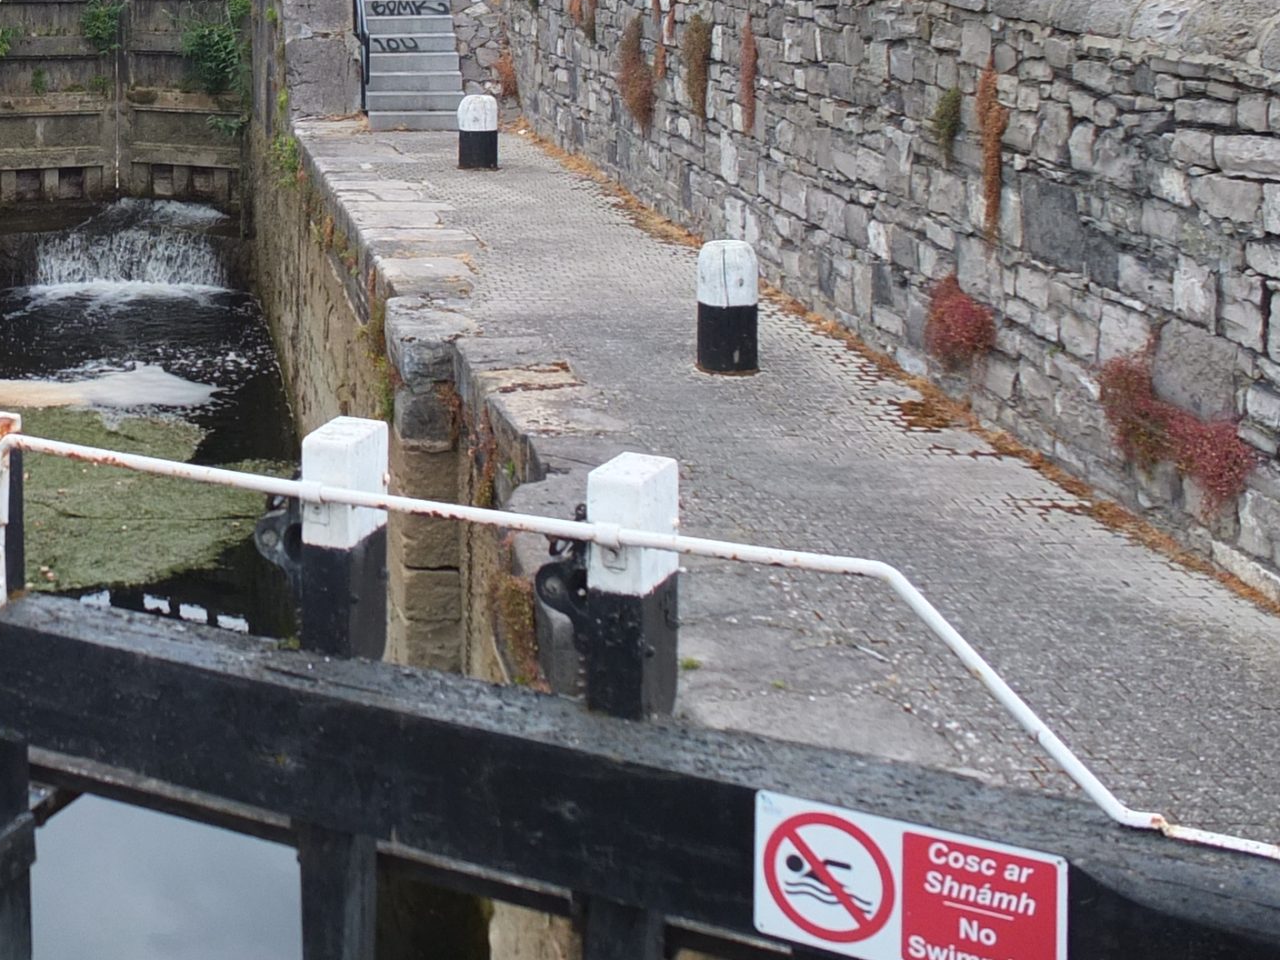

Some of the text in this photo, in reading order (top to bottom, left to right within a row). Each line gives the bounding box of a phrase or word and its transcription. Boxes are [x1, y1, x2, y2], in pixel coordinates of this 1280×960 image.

[928, 842, 1034, 883] Cosc ar
[924, 871, 1036, 916] Shnámh
[959, 917, 997, 946] No
